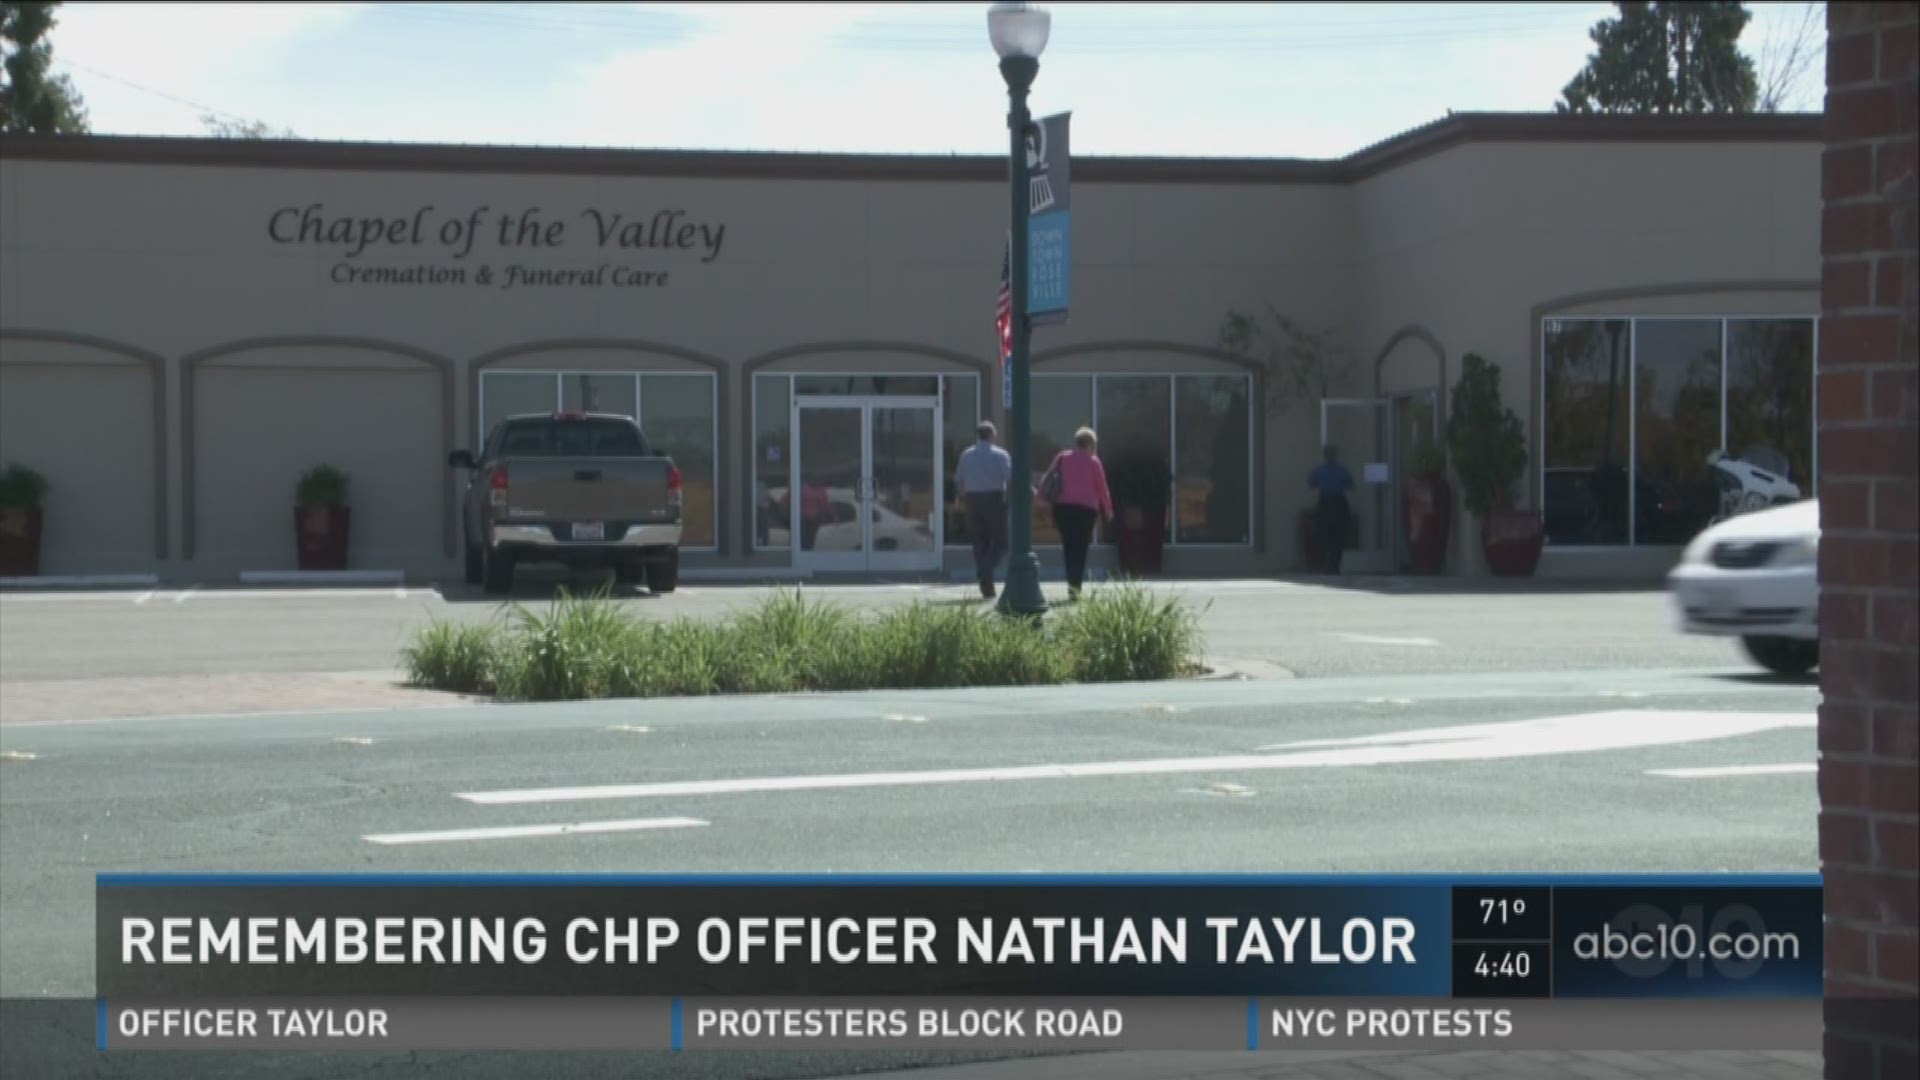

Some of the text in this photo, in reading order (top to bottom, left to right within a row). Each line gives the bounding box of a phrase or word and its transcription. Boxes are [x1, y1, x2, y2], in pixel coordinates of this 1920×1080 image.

[267, 204, 726, 262] Chapel of the Valley
[330, 263, 669, 289] Cremation & Funeral Care
